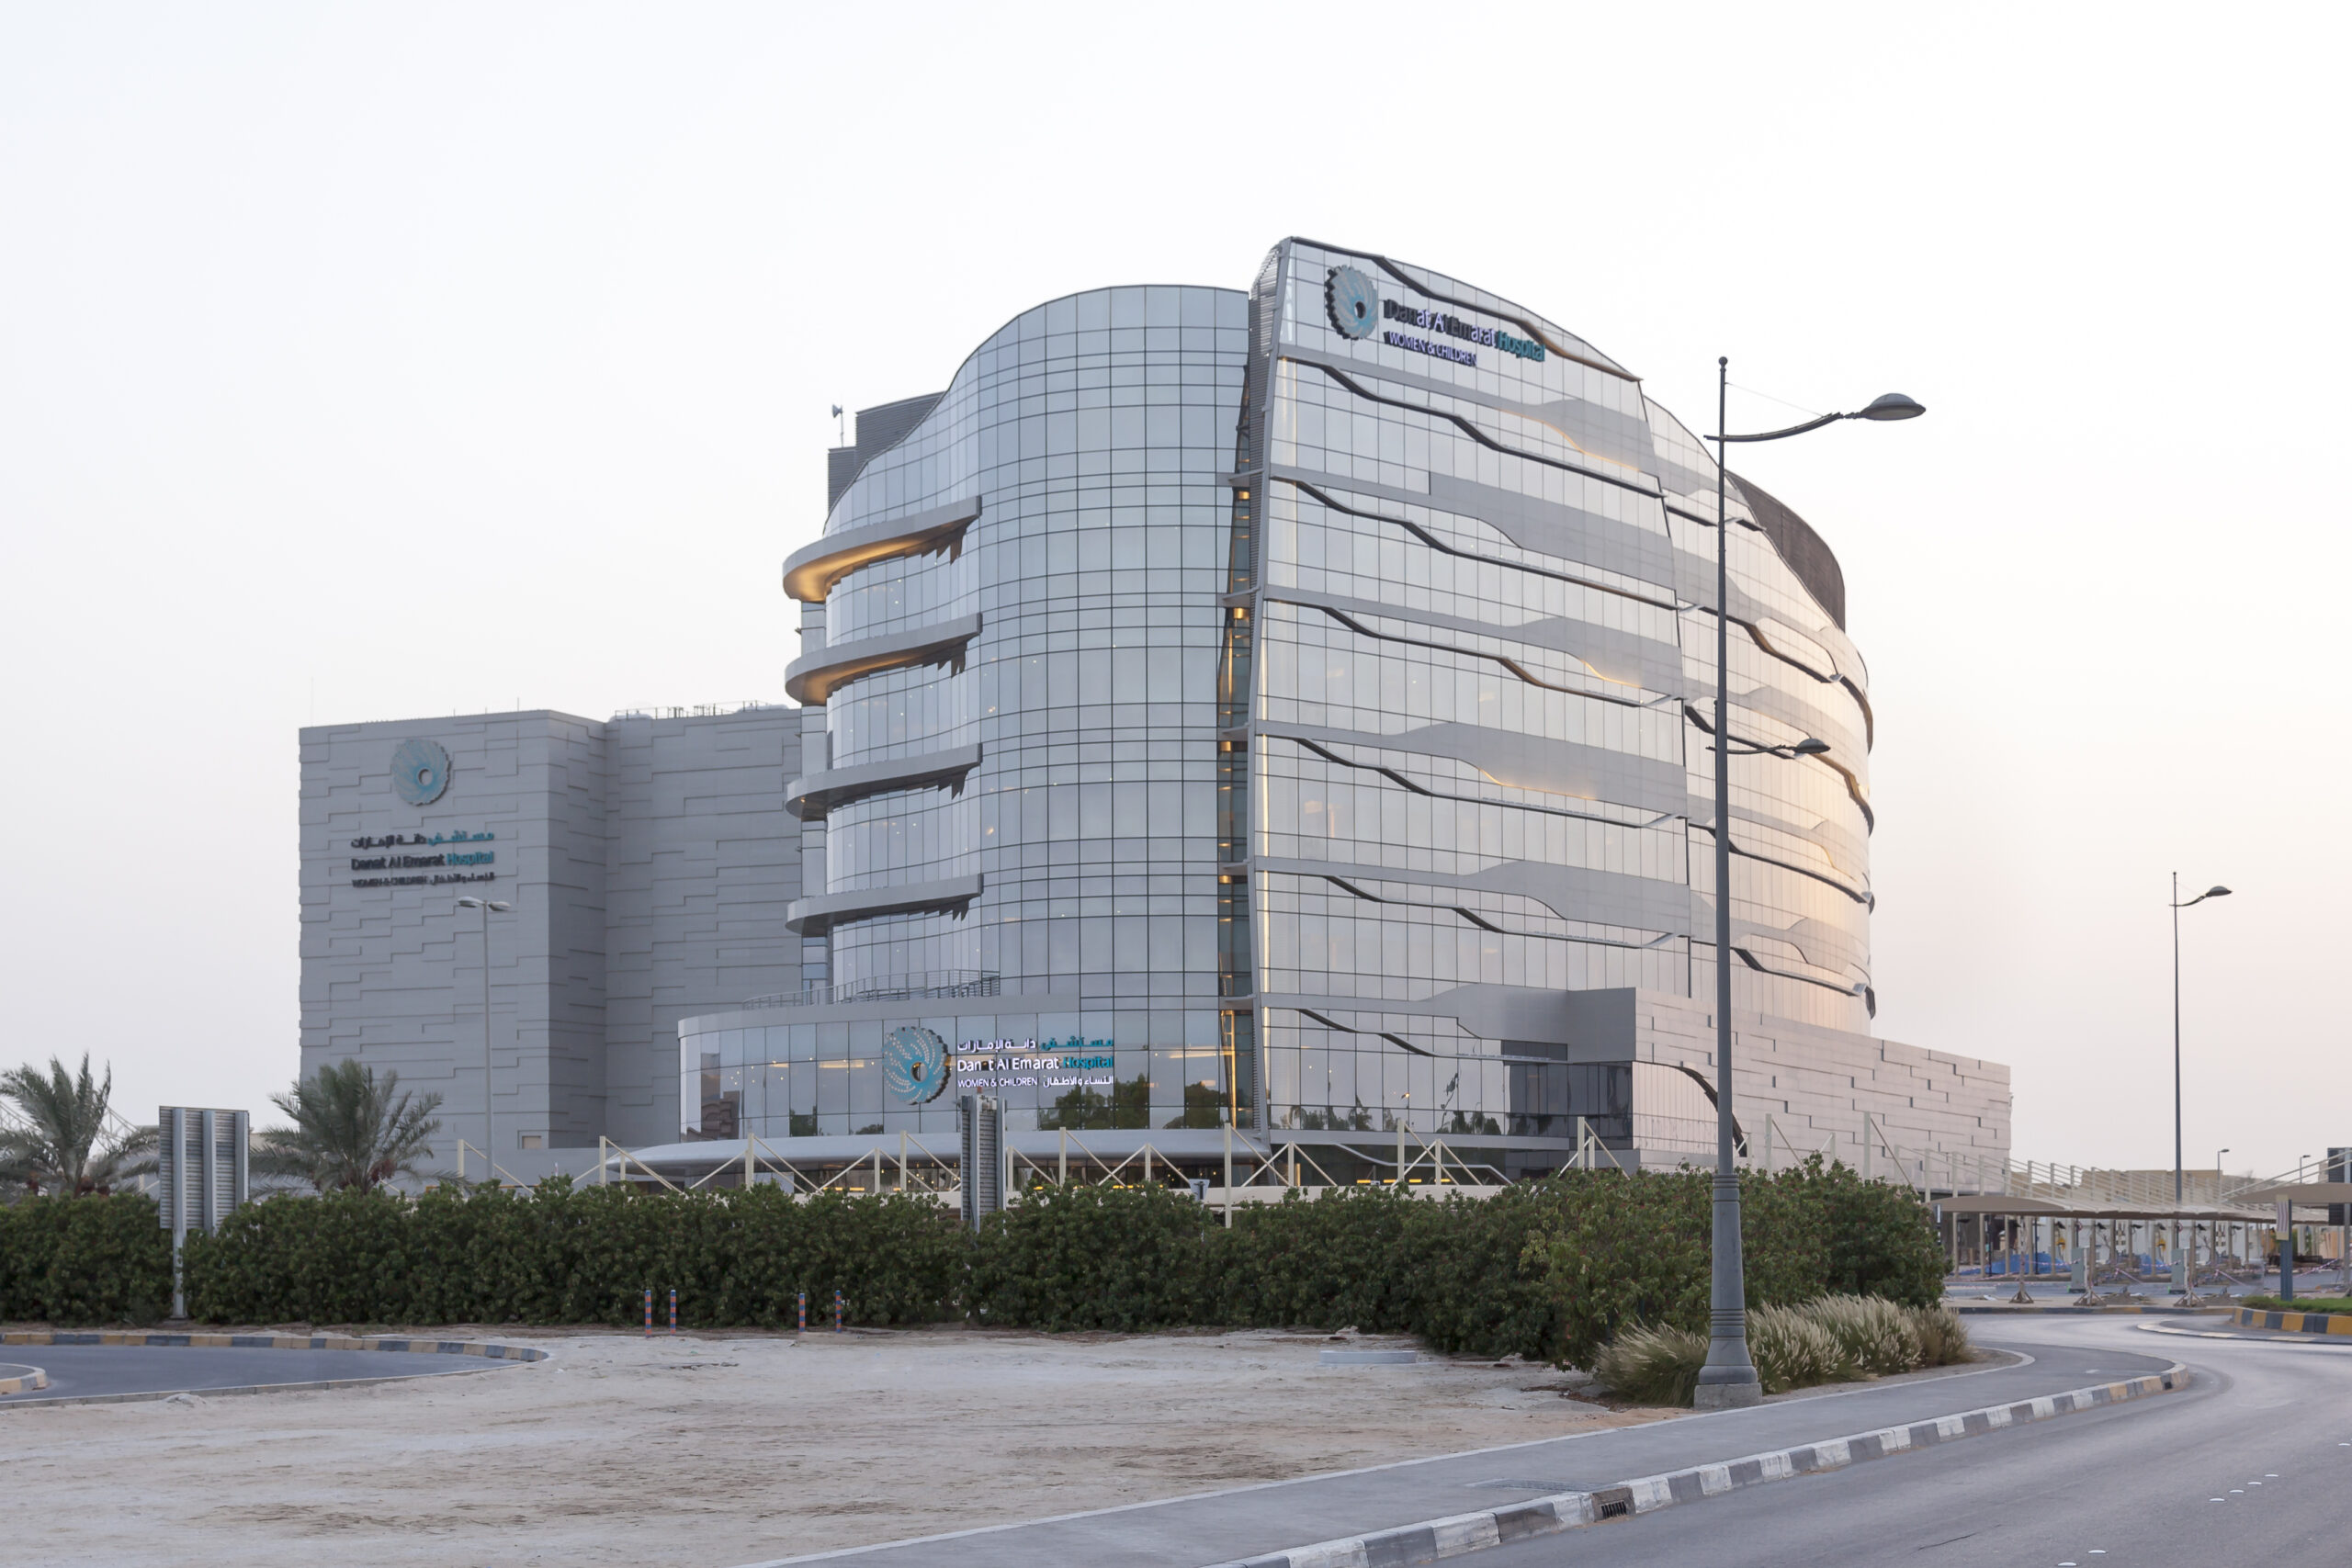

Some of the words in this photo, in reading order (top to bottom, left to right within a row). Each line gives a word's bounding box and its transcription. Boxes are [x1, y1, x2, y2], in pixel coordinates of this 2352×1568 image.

[1384, 299, 1430, 329] Danat
[1449, 315, 1497, 347] Emarat
[1497, 331, 1546, 362] Hospital
[1384, 330, 1426, 355] WOMEN
[1426, 341, 1436, 355] &
[1436, 344, 1477, 367] CHILDREN
[351, 856, 386, 870] Danat
[389, 856, 401, 868] Al
[402, 853, 445, 867] Emarat
[447, 851, 494, 866] Hospital
[957, 1058, 994, 1072] Dant
[997, 1057, 1010, 1071] Al
[1012, 1057, 1059, 1071] Emarat
[1063, 1055, 1114, 1070] Hospital
[957, 1077, 989, 1088] WOMEN
[989, 1077, 998, 1088] &
[999, 1077, 1038, 1088] CHILDREN
[1083, 1075, 1114, 1086] النساء
